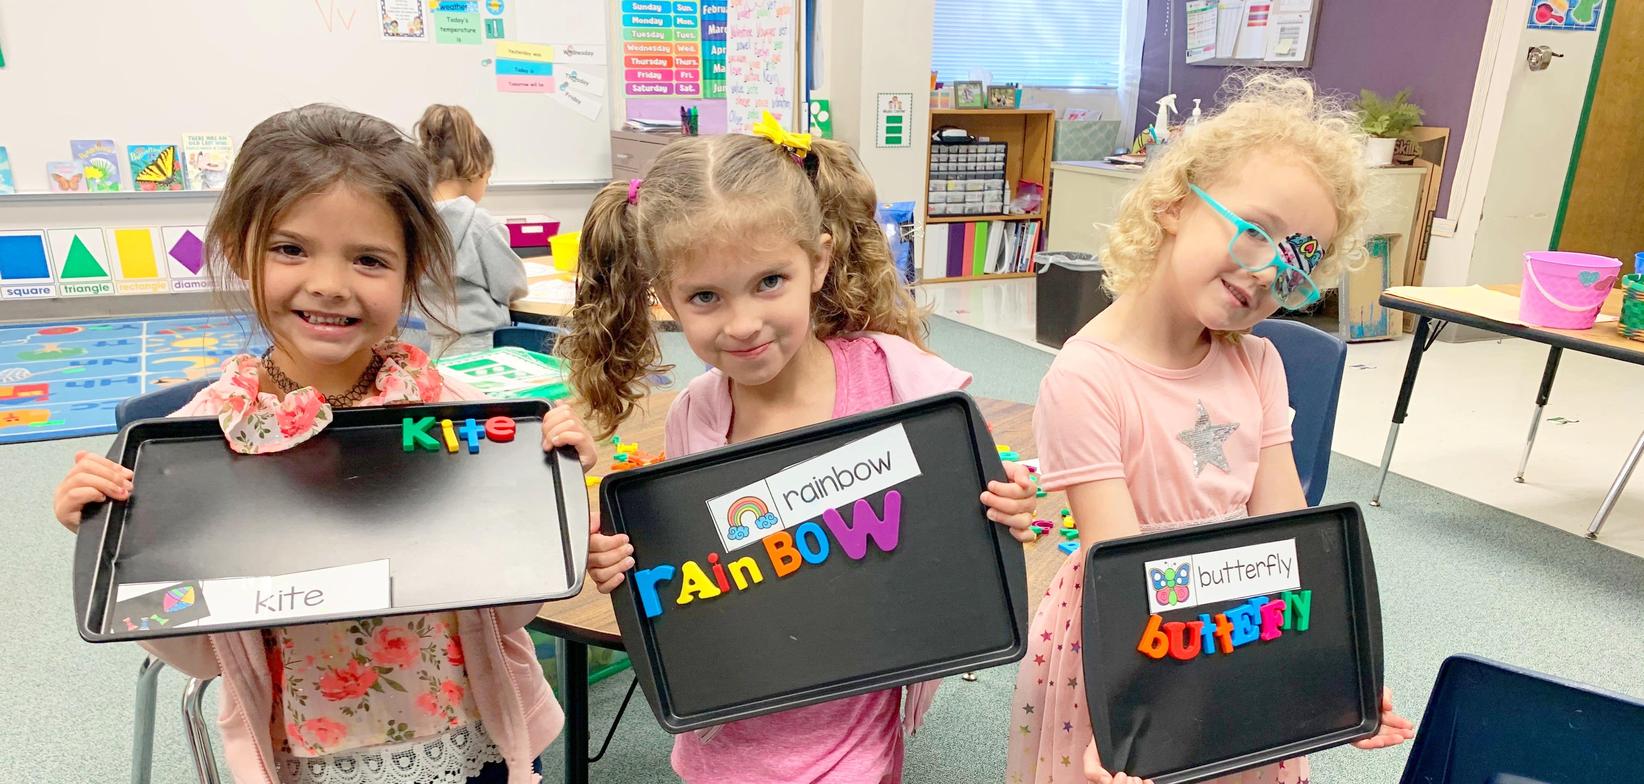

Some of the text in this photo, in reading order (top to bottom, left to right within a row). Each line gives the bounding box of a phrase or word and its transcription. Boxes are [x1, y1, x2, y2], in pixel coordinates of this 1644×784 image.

[632, 3, 662, 12] Sunday
[702, 4, 728, 15] Febru
[446, 16, 469, 24] Today's
[631, 16, 664, 26] Monday
[677, 17, 695, 25] Mon.
[631, 30, 665, 39] Tuesday
[676, 31, 696, 39] Tues.
[626, 44, 671, 53] Wednesday
[631, 57, 668, 67] Thursday
[675, 58, 698, 66] Thurs.
[713, 63, 726, 74] Ma
[637, 71, 662, 80] Friday
[680, 71, 694, 79] Fri.
[632, 84, 668, 93] Saturday
[679, 84, 696, 92] Sat.
[64, 283, 110, 295] triangle
[119, 281, 167, 291] rectangle
[7, 286, 51, 296] square
[782, 451, 893, 511] rainbow
[1198, 553, 1293, 588] butterfly
[255, 585, 325, 614] kite
